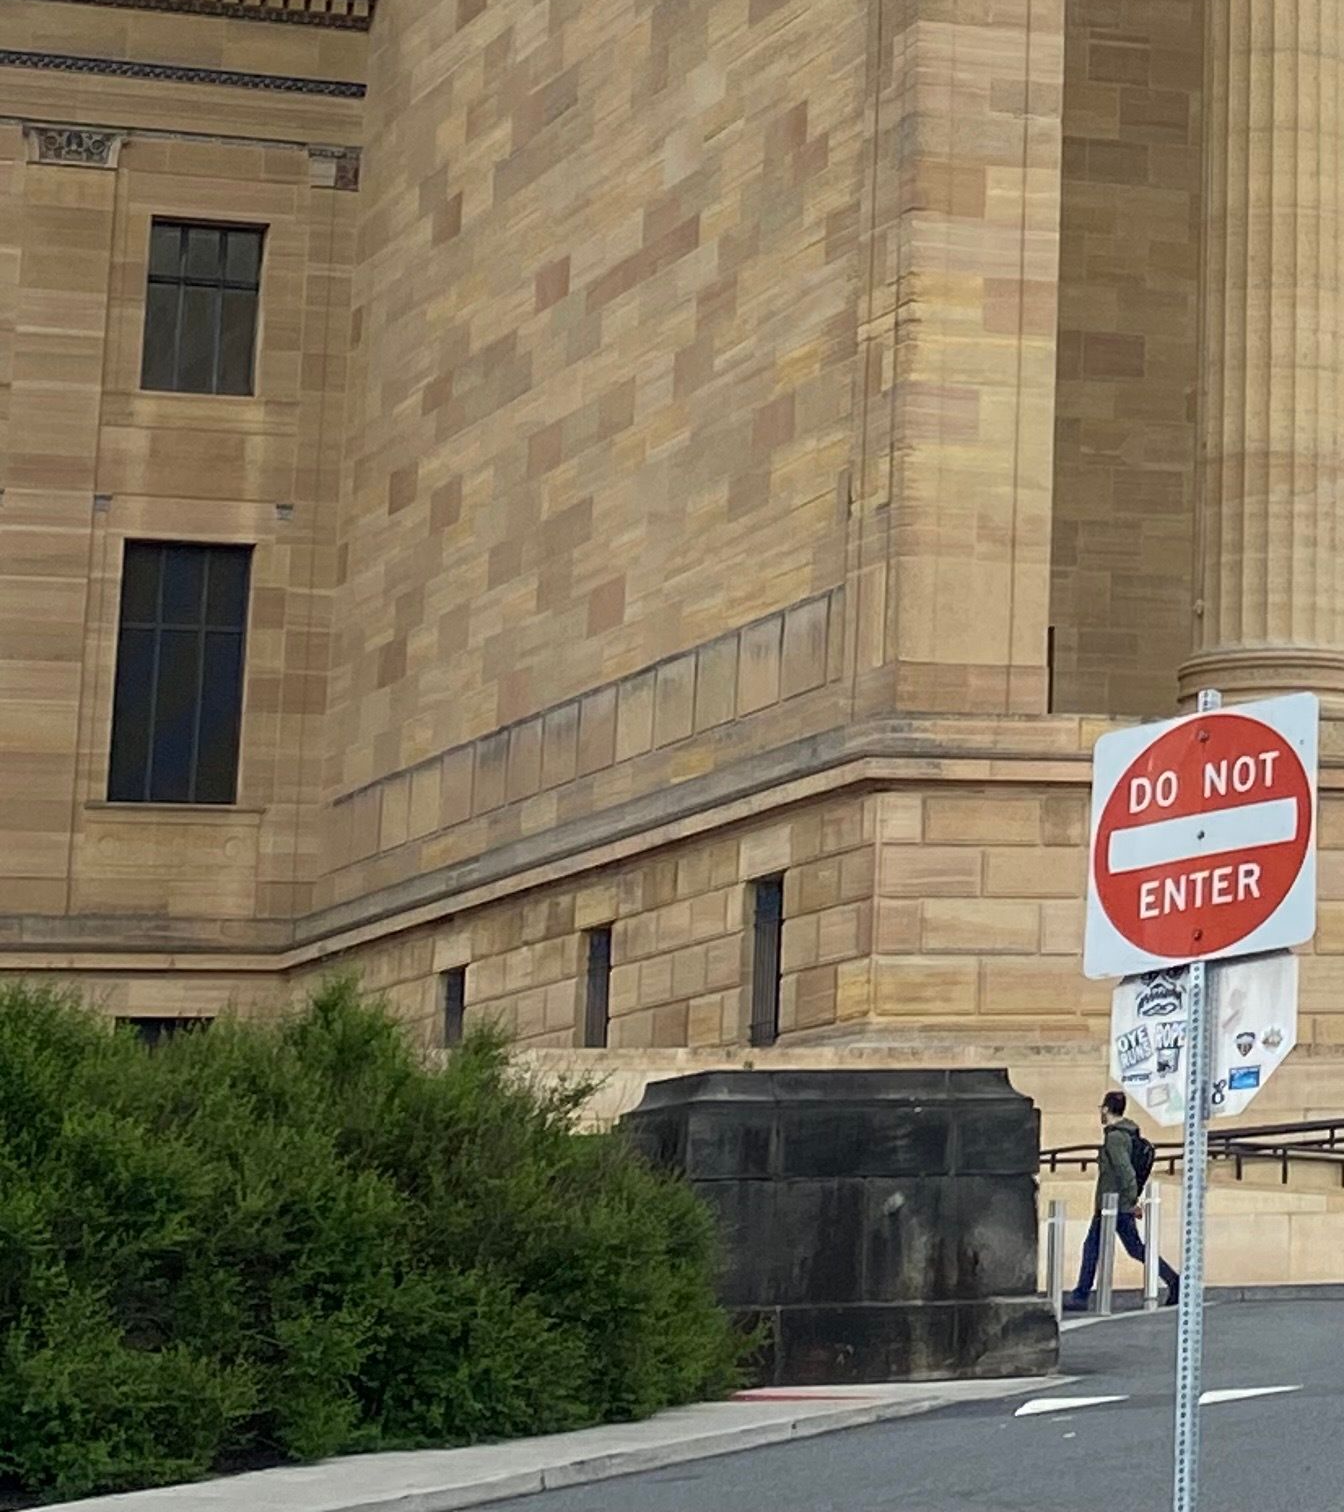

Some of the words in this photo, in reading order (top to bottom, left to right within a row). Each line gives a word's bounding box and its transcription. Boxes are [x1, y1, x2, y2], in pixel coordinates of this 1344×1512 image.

[1128, 770, 1179, 815] DO
[1203, 750, 1280, 799] NOT
[1138, 862, 1261, 920] ENTER
